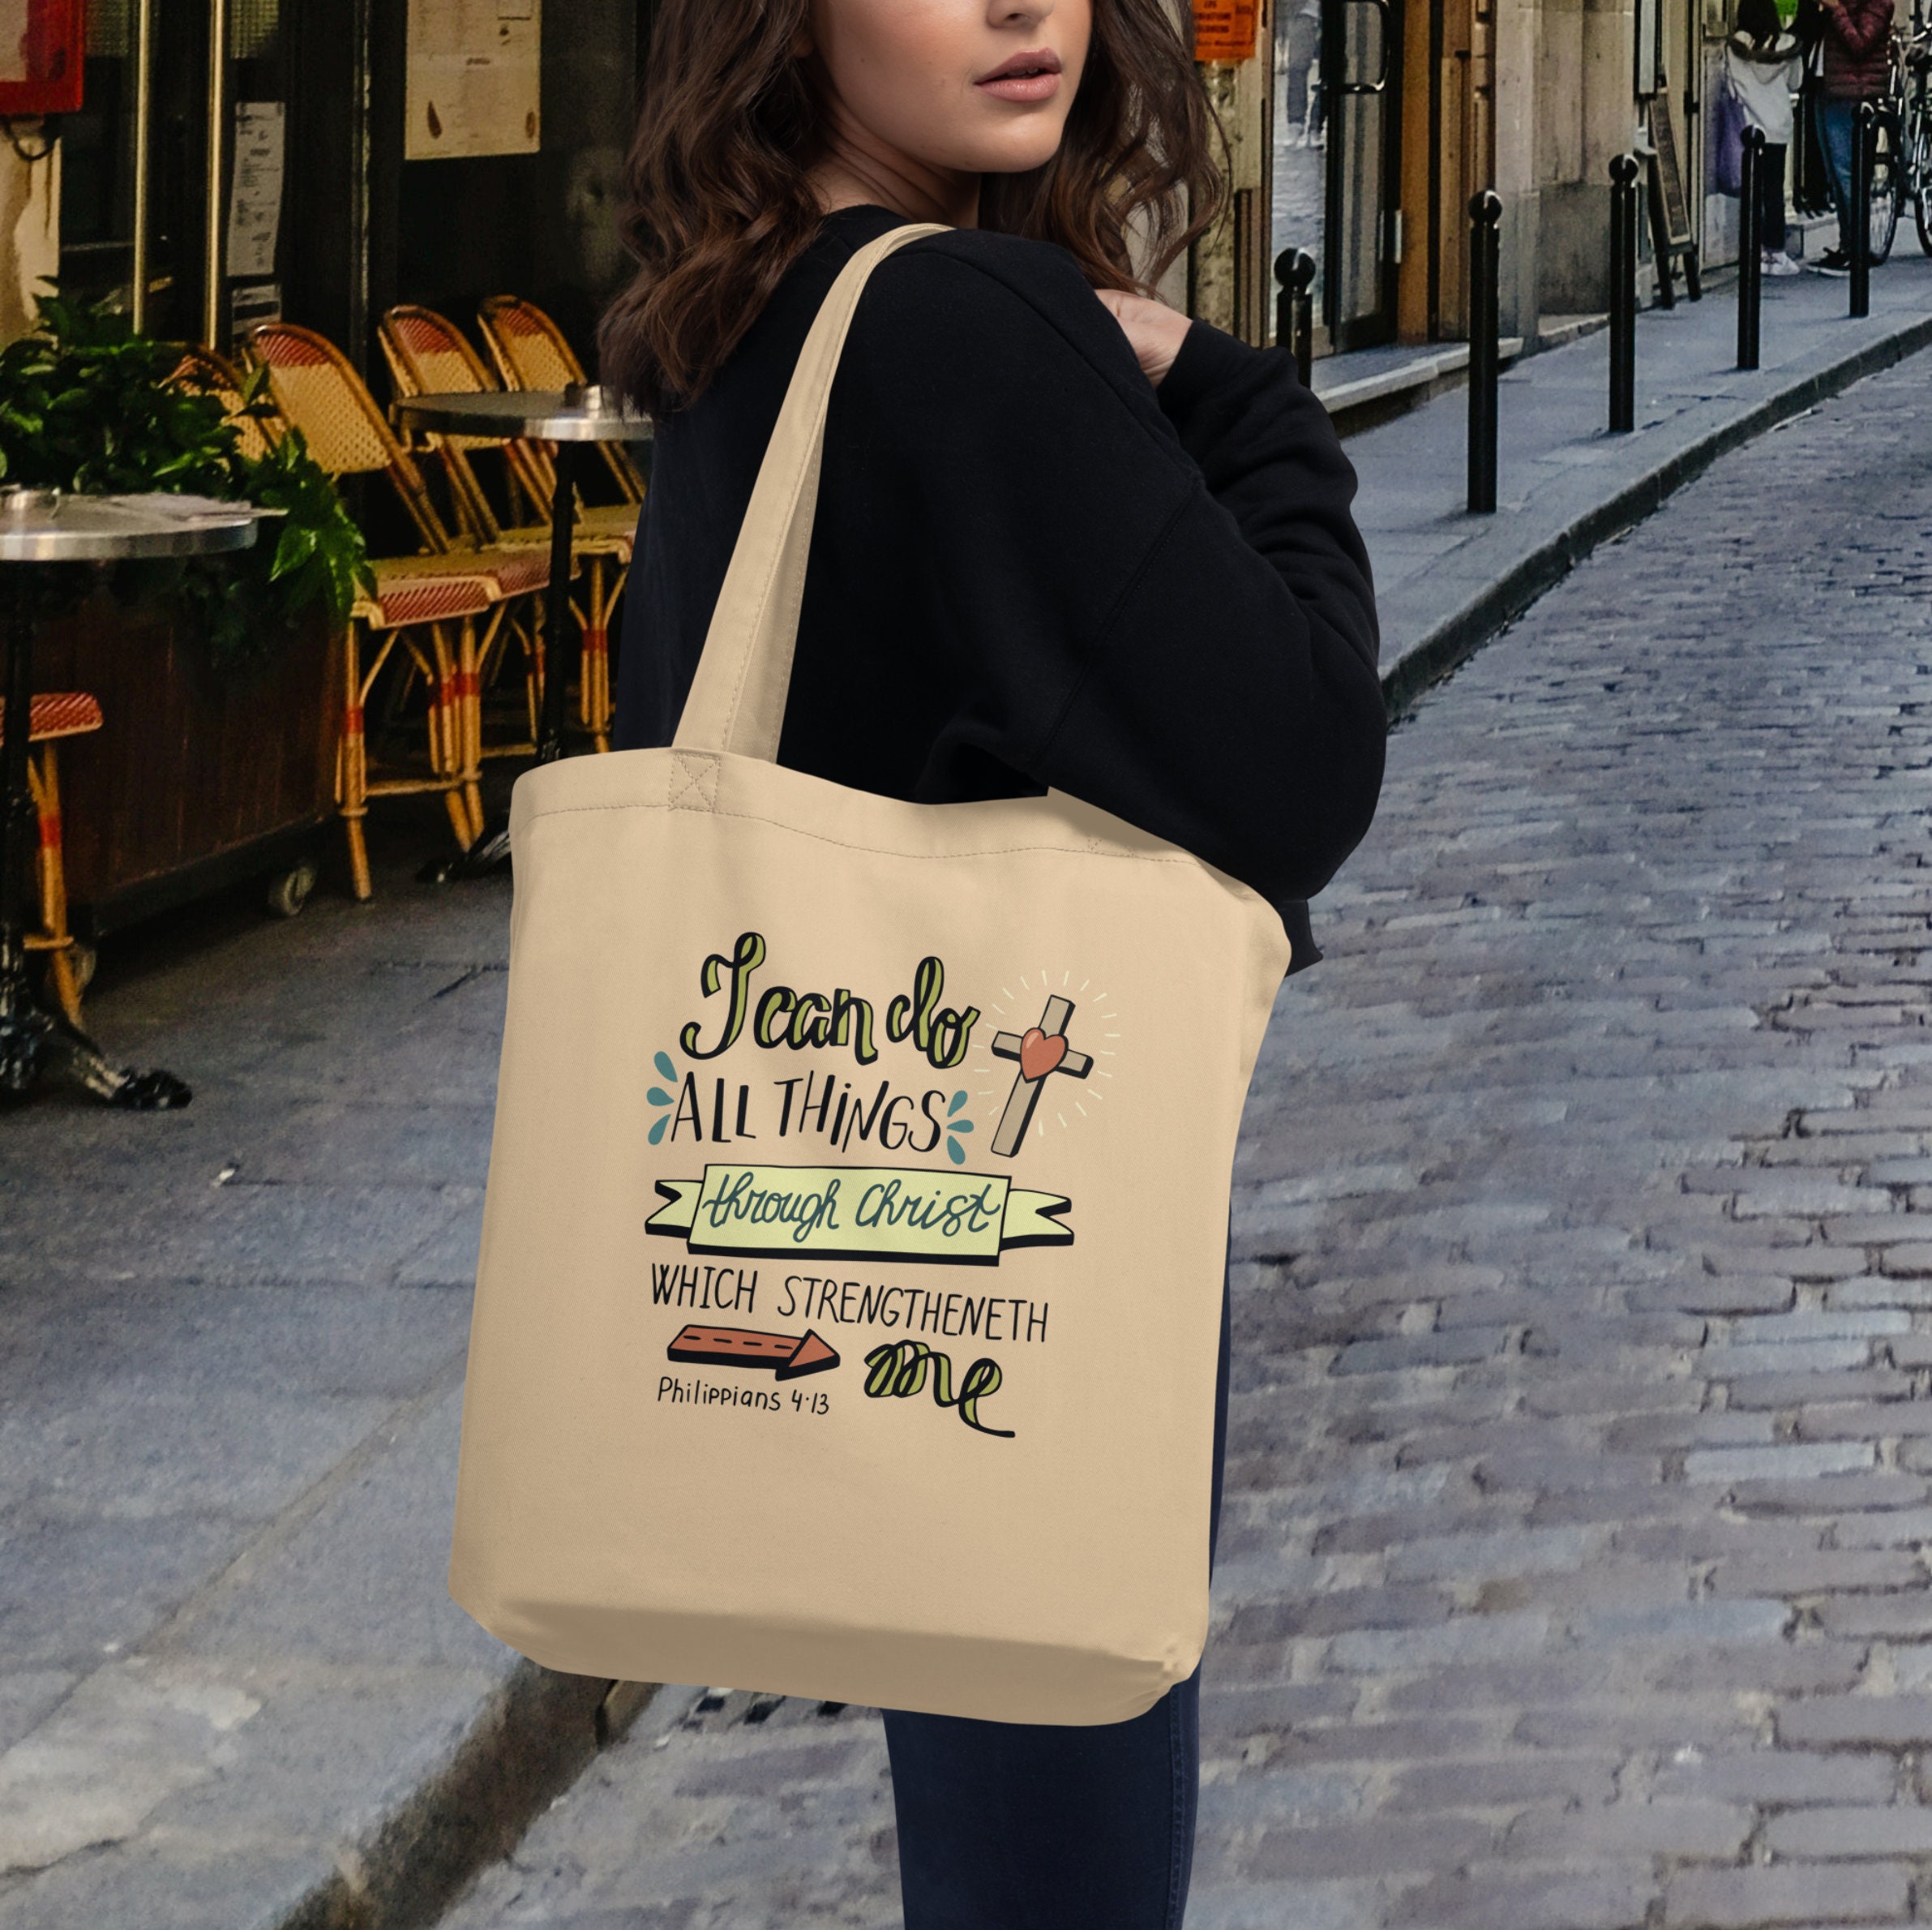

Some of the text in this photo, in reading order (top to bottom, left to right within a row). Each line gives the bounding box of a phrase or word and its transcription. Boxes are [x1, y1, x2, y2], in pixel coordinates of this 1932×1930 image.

[753, 985, 879, 1066] can
[885, 955, 982, 1070] do
[670, 1070, 756, 1143] ALL
[701, 1171, 1001, 1243] through Christ
[651, 1263, 1049, 1344] WHICH STRENGTHENETH
[657, 1375, 782, 1412] Philippians
[863, 1339, 1017, 1439] me
